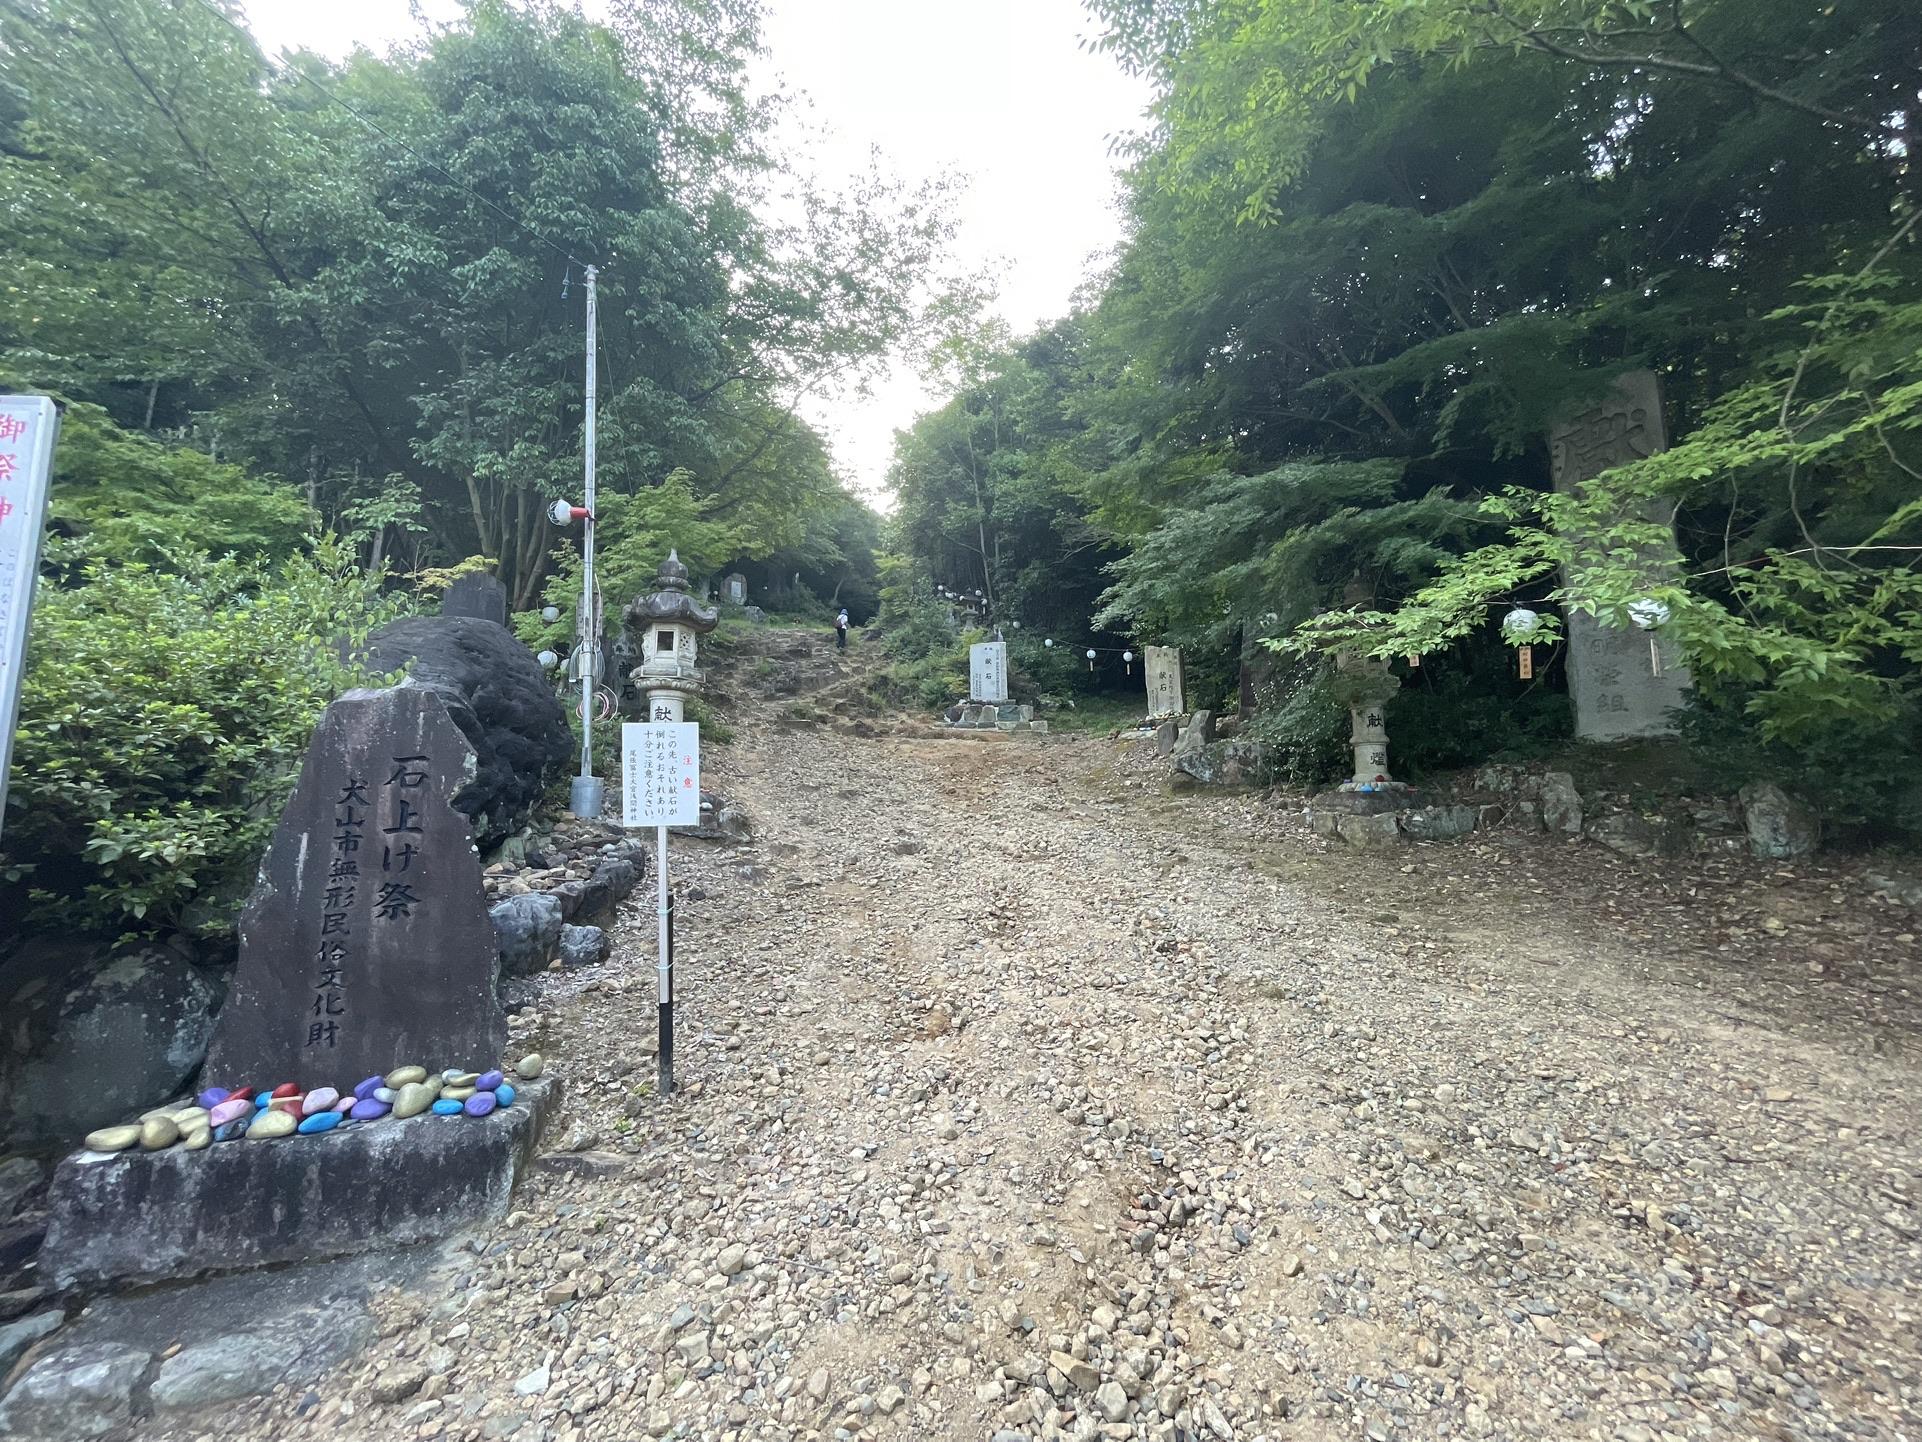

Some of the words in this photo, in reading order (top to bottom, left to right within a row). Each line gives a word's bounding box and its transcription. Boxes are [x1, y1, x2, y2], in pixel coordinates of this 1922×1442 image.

[644, 730, 655, 819] 十分ご注意ください。
[668, 730, 678, 816] この先、古い献石が
[683, 755, 693, 789] 注意
[374, 754, 431, 921] 石上げ祭
[304, 778, 371, 1049] 犬山市無形民俗文化財
